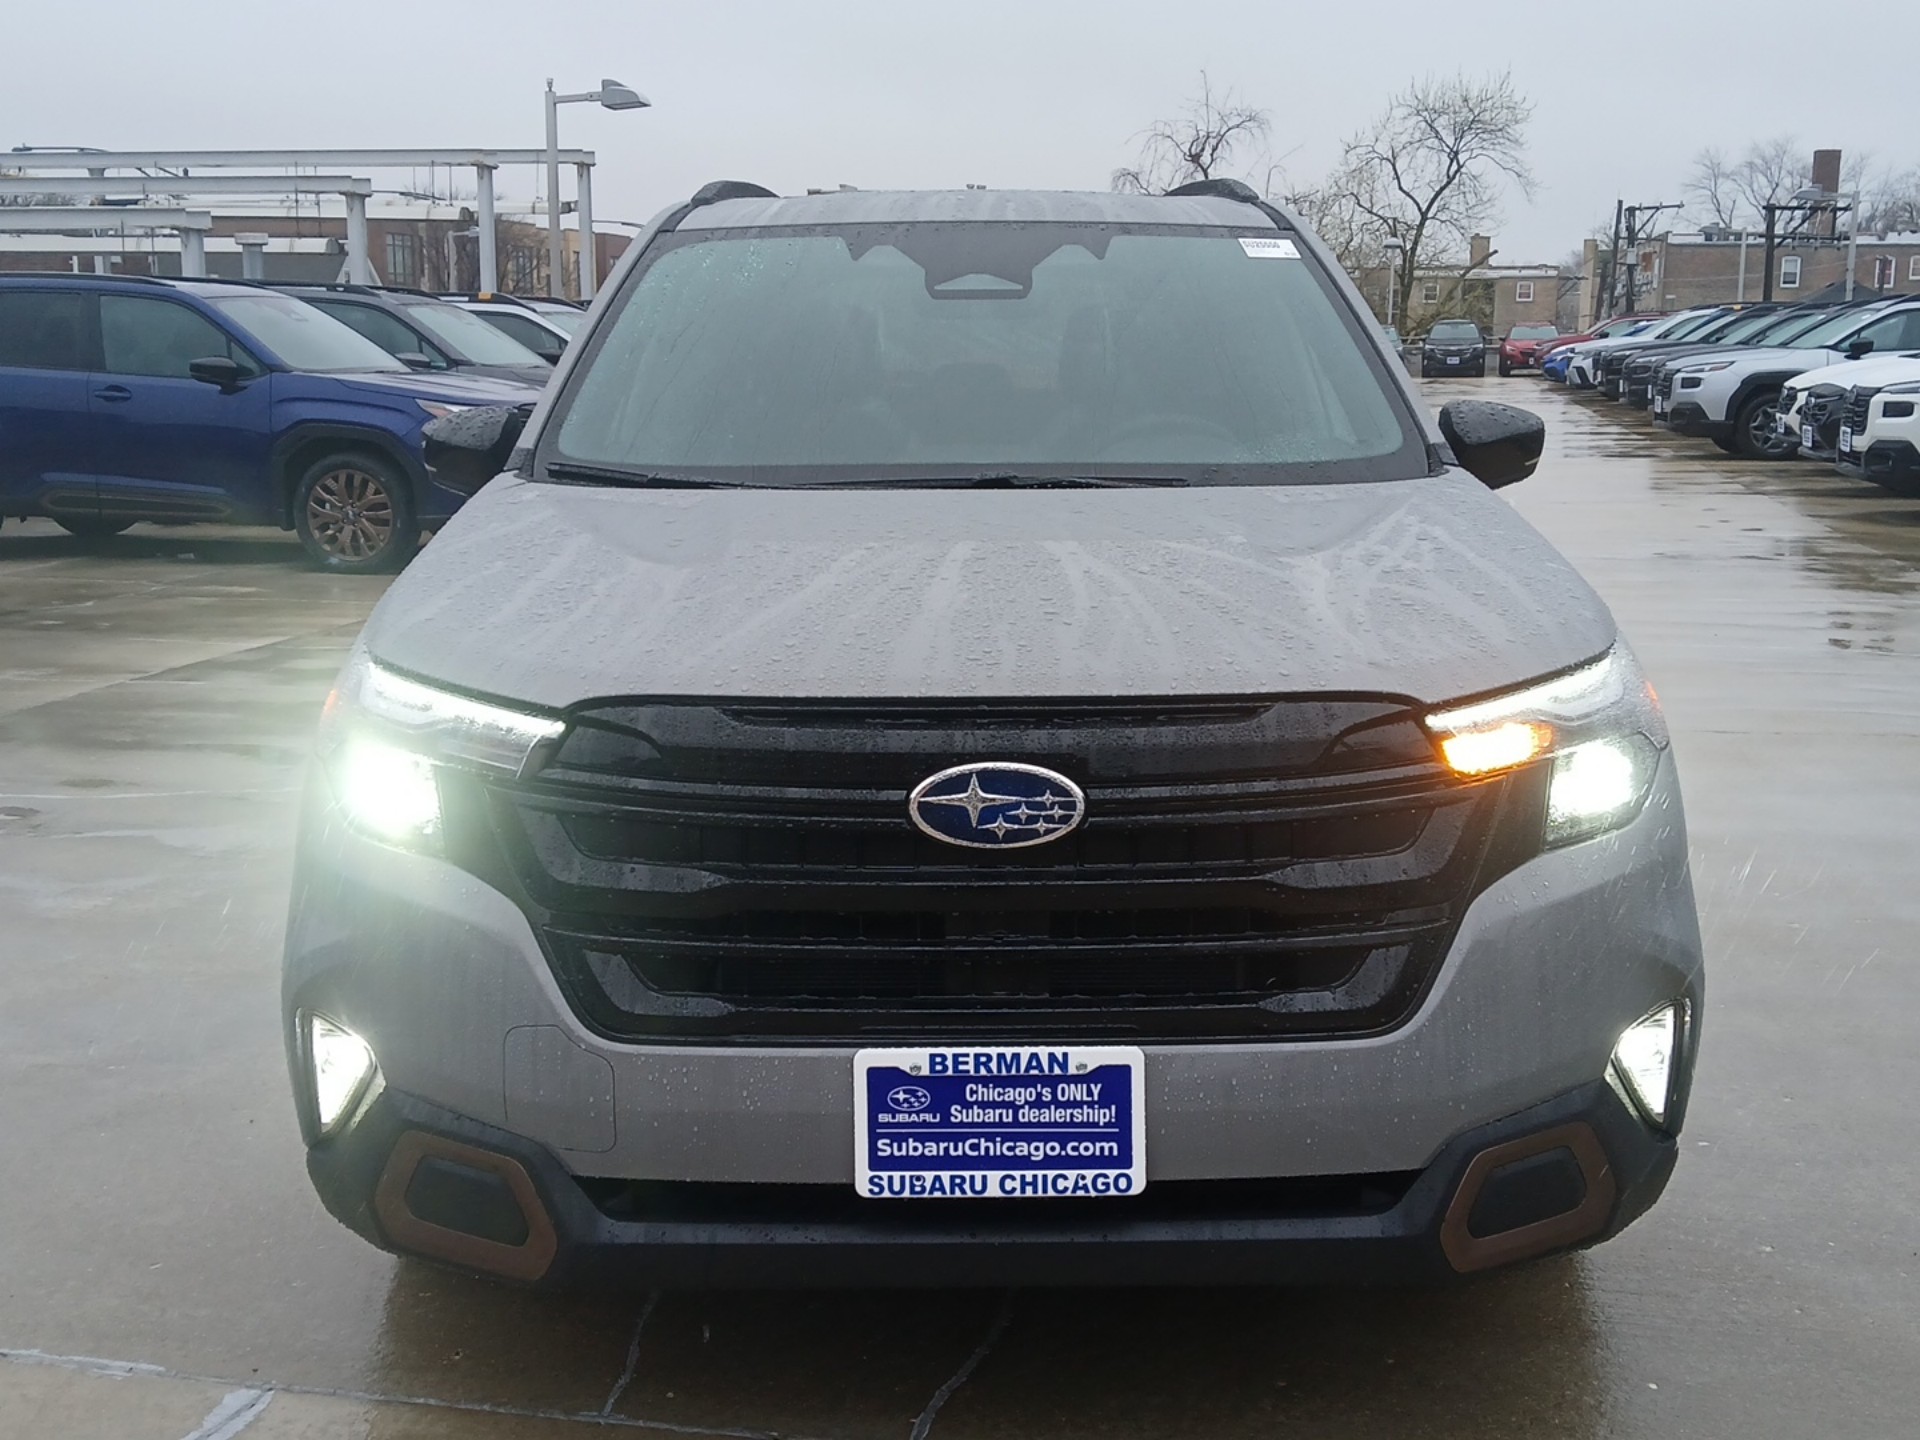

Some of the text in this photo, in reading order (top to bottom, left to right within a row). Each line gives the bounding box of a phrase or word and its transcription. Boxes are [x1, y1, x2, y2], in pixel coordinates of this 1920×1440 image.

[929, 1052, 1069, 1075] BERMAN
[965, 1083, 1102, 1105] Chicago's ONLY
[878, 1113, 940, 1123] SUBARU
[950, 1104, 1116, 1126] Subaru dealership!
[876, 1137, 1118, 1161] SubaruChicago.com
[867, 1172, 1133, 1196] SUBARU CHICAGO
